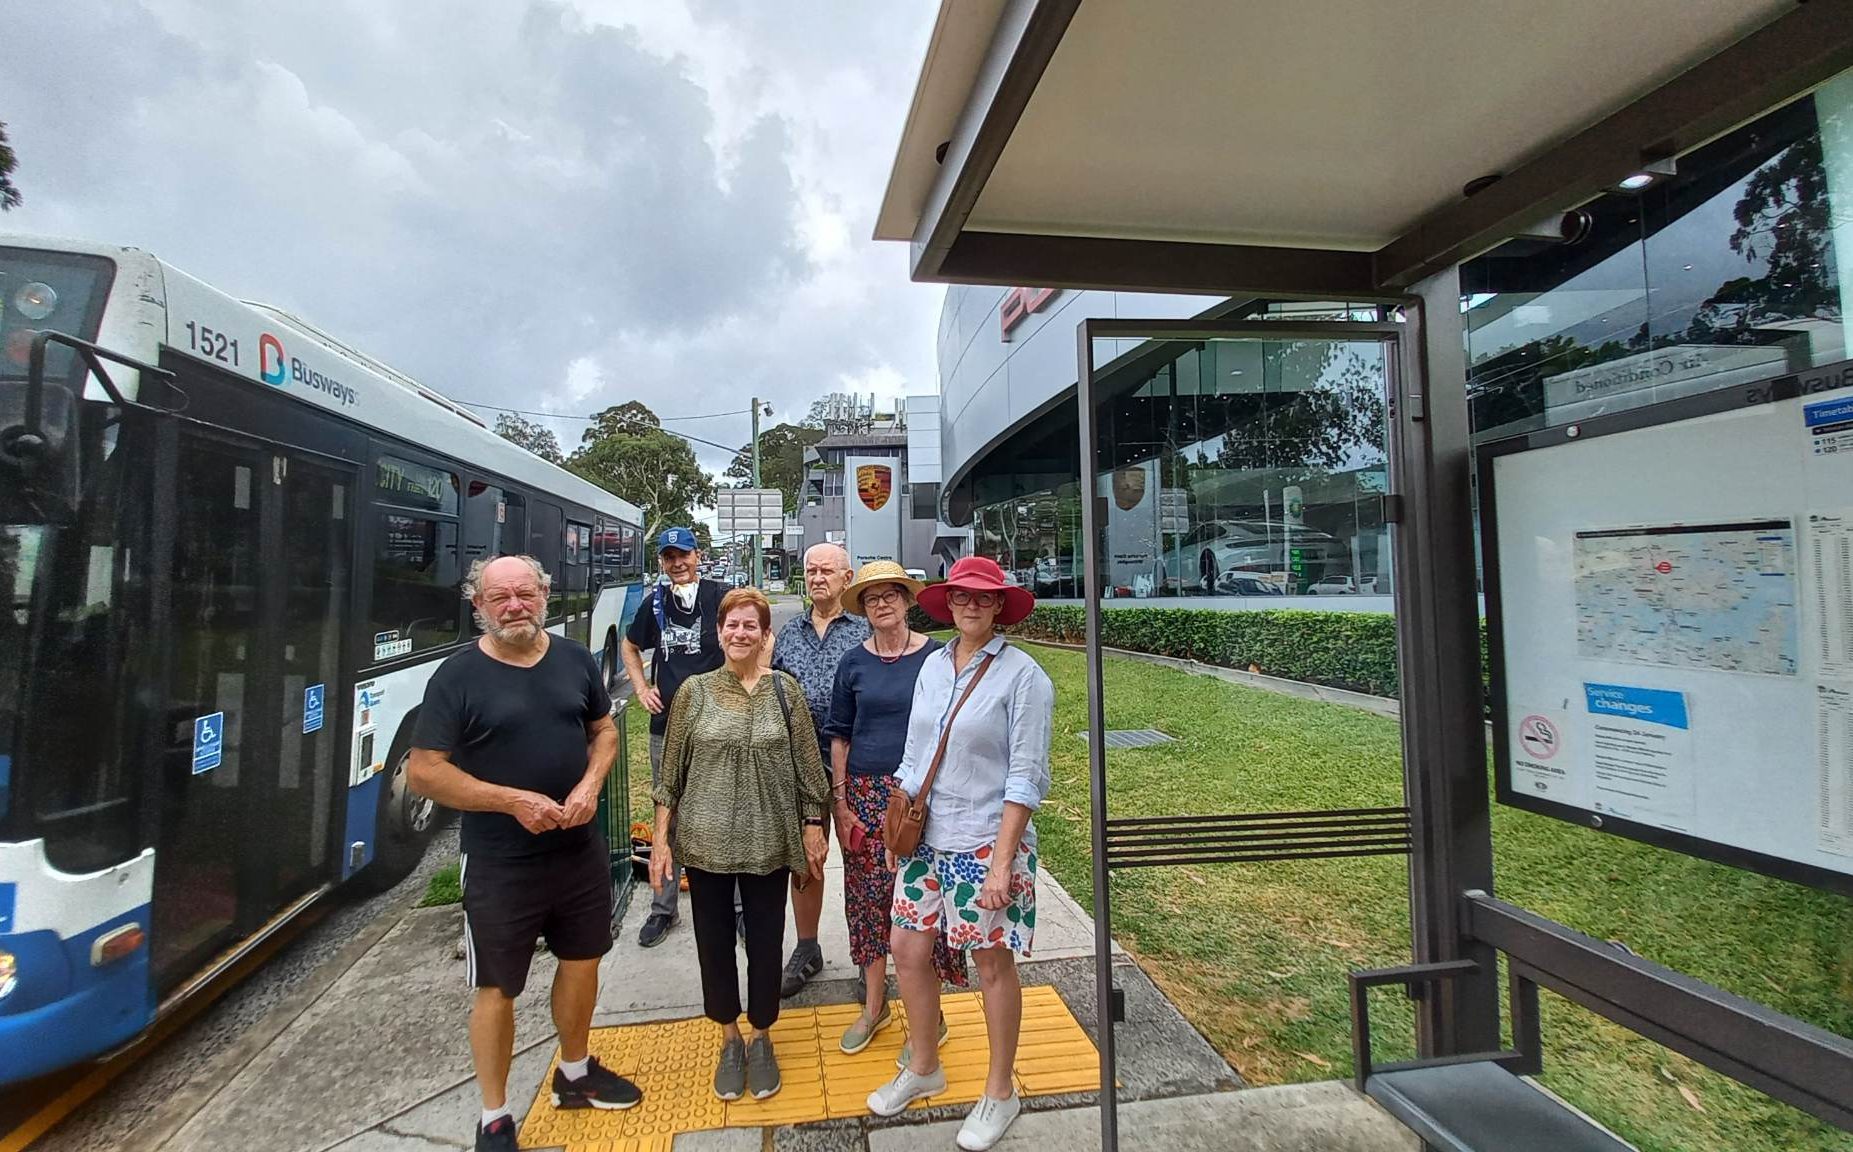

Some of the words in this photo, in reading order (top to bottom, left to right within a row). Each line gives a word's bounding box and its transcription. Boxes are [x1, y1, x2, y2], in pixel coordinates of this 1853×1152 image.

[186, 320, 239, 366] 1521
[291, 357, 357, 406] Busways
[1587, 687, 1624, 699] Service
[1596, 698, 1654, 715] changes
